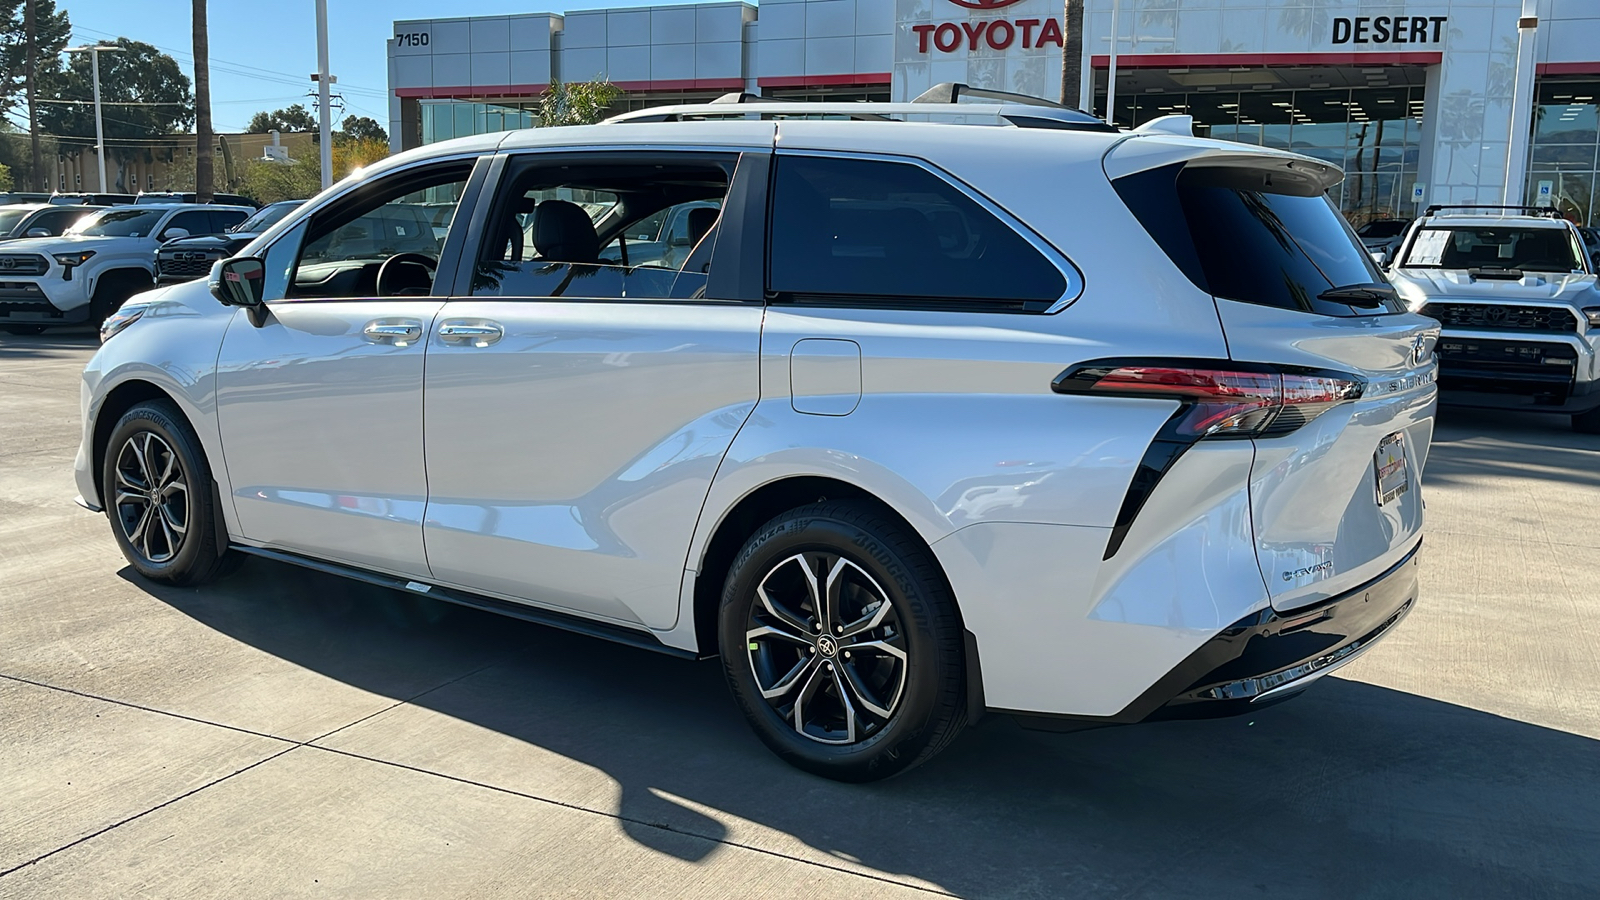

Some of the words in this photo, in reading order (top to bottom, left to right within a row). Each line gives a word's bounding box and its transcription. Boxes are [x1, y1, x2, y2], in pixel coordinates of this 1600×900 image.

[396, 32, 430, 47] 7150
[912, 18, 1064, 53] TOYOTA
[1332, 16, 1448, 44] DESERT
[122, 410, 170, 430] BRIDGESTONE
[732, 524, 786, 578] TURANZA
